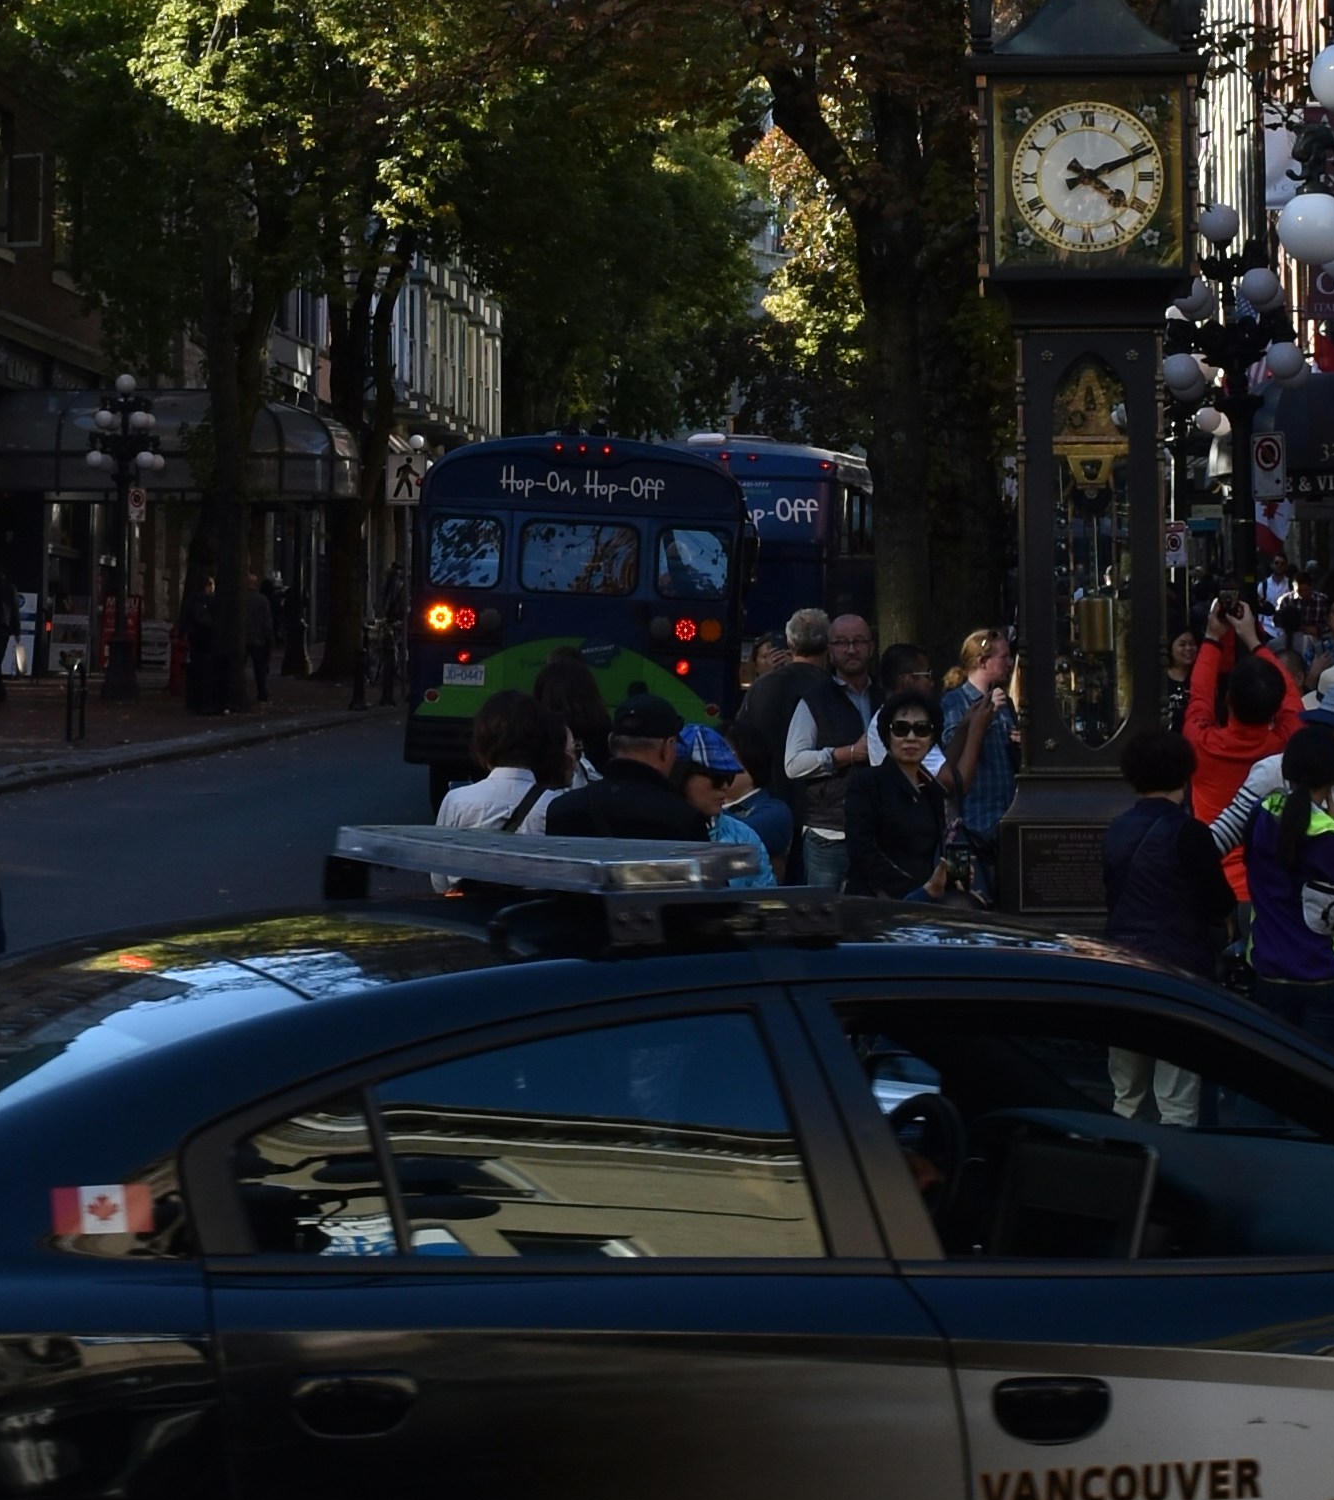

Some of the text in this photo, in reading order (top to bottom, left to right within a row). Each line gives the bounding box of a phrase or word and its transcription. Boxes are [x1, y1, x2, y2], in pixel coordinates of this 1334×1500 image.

[499, 464, 666, 504] Hop-On, Hop-Off
[1298, 475, 1312, 492] &
